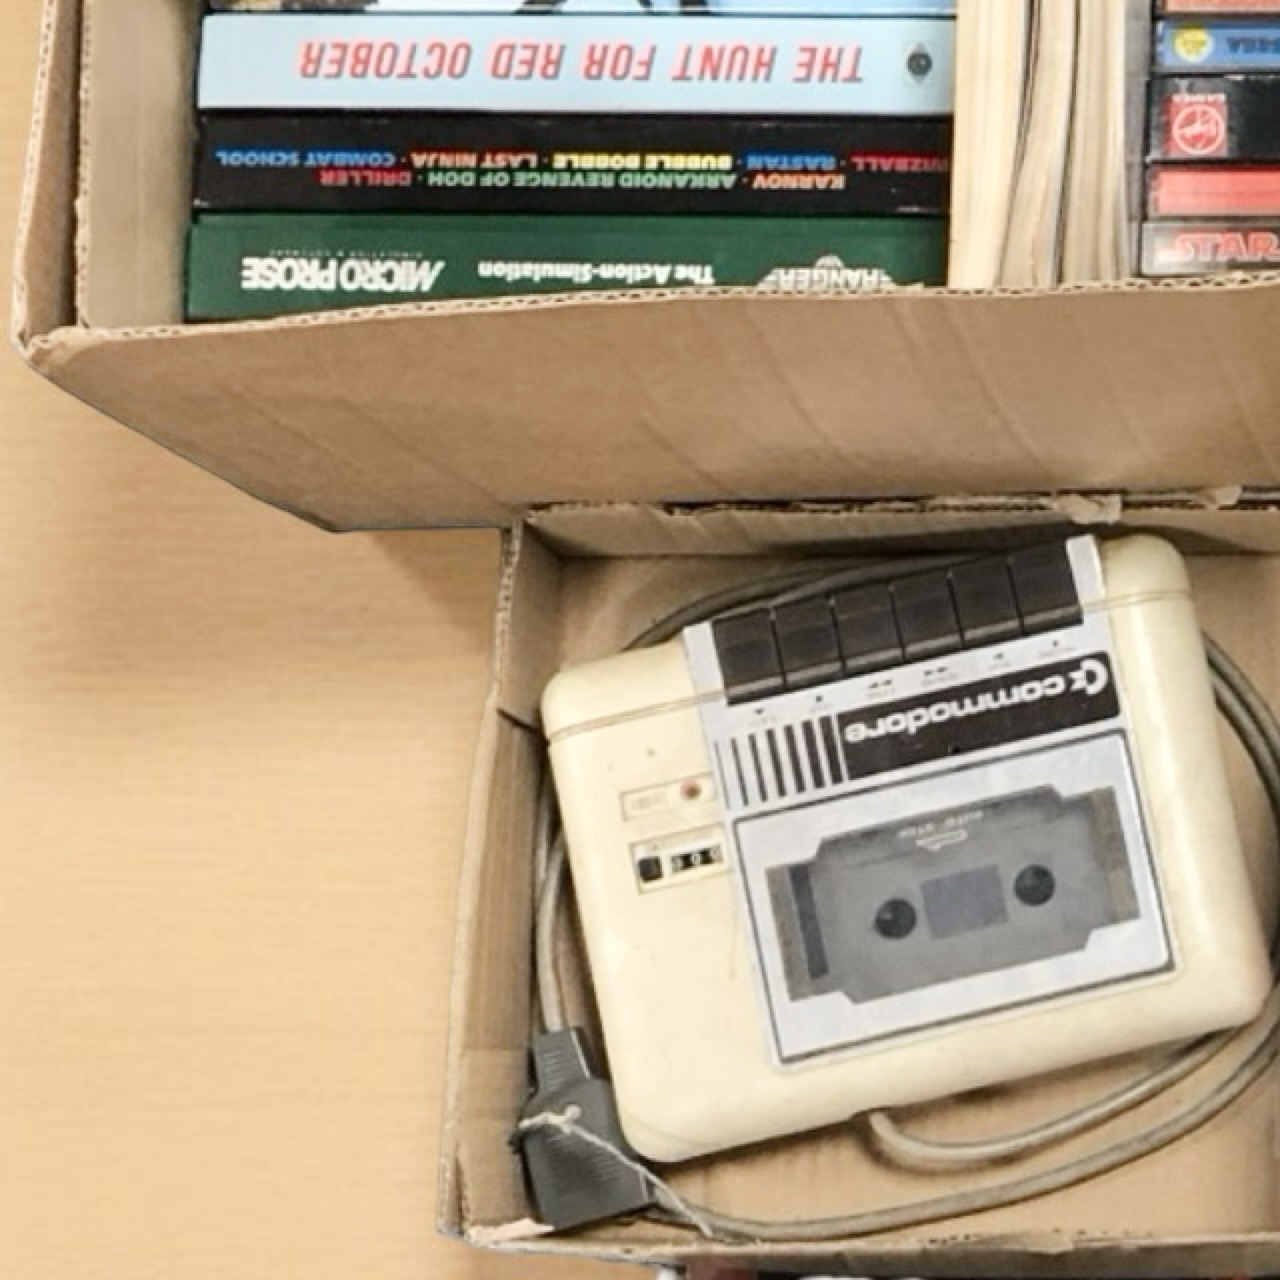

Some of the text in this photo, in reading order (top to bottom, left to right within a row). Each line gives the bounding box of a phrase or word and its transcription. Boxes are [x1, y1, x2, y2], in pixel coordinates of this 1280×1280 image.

[298, 42, 865, 83] THE HUNT FOR RED OCTOBER
[216, 151, 301, 169] SCHOOL
[305, 152, 397, 169] COMBAT
[411, 153, 478, 170] NINJA
[483, 153, 539, 170] LAST
[554, 154, 641, 170] BOBBLE
[646, 154, 732, 170] BUBBLE
[746, 154, 837, 171] RASTAN
[320, 170, 845, 189] KARNOV ARKANOID REVENGE OF DOH DRILLER
[479, 261, 671, 285] Action-Simulation
[675, 265, 716, 286] The
[843, 677, 1066, 744] commodore
